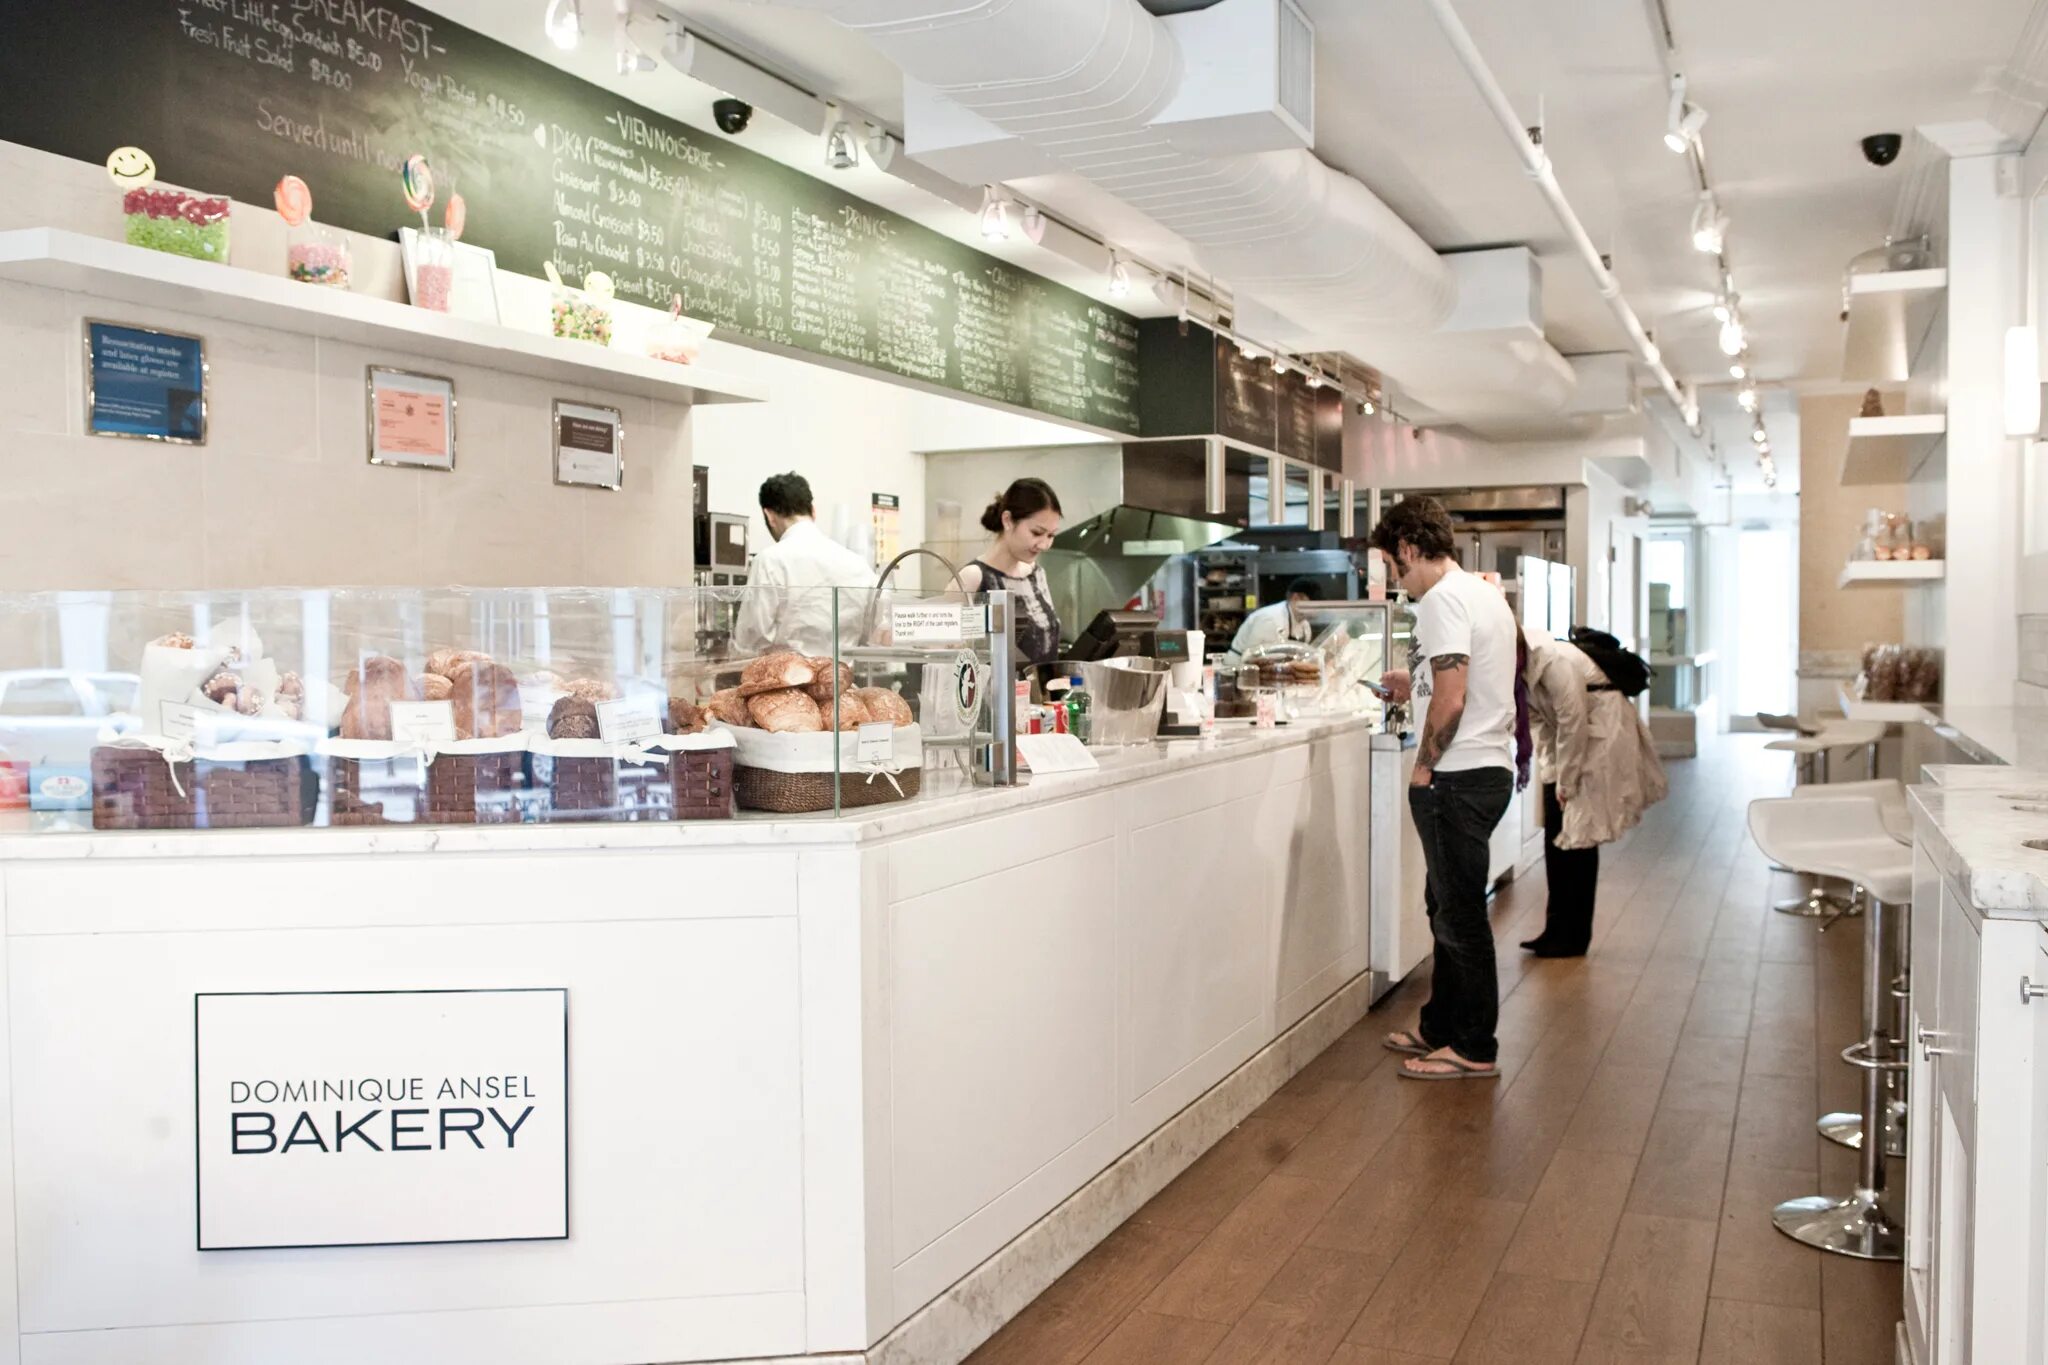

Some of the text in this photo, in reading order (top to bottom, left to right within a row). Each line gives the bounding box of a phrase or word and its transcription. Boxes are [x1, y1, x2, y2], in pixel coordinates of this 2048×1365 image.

[178, 8, 294, 73] Fresh Fruit Salad
[256, 98, 327, 152] Served
[329, 131, 371, 164] until
[550, 123, 586, 163] DKA
[552, 157, 601, 195] Croissant
[553, 219, 578, 247] Pain
[230, 1075, 536, 1104] DOMINIQUE ANSEL
[231, 1105, 536, 1155] BAKERY
